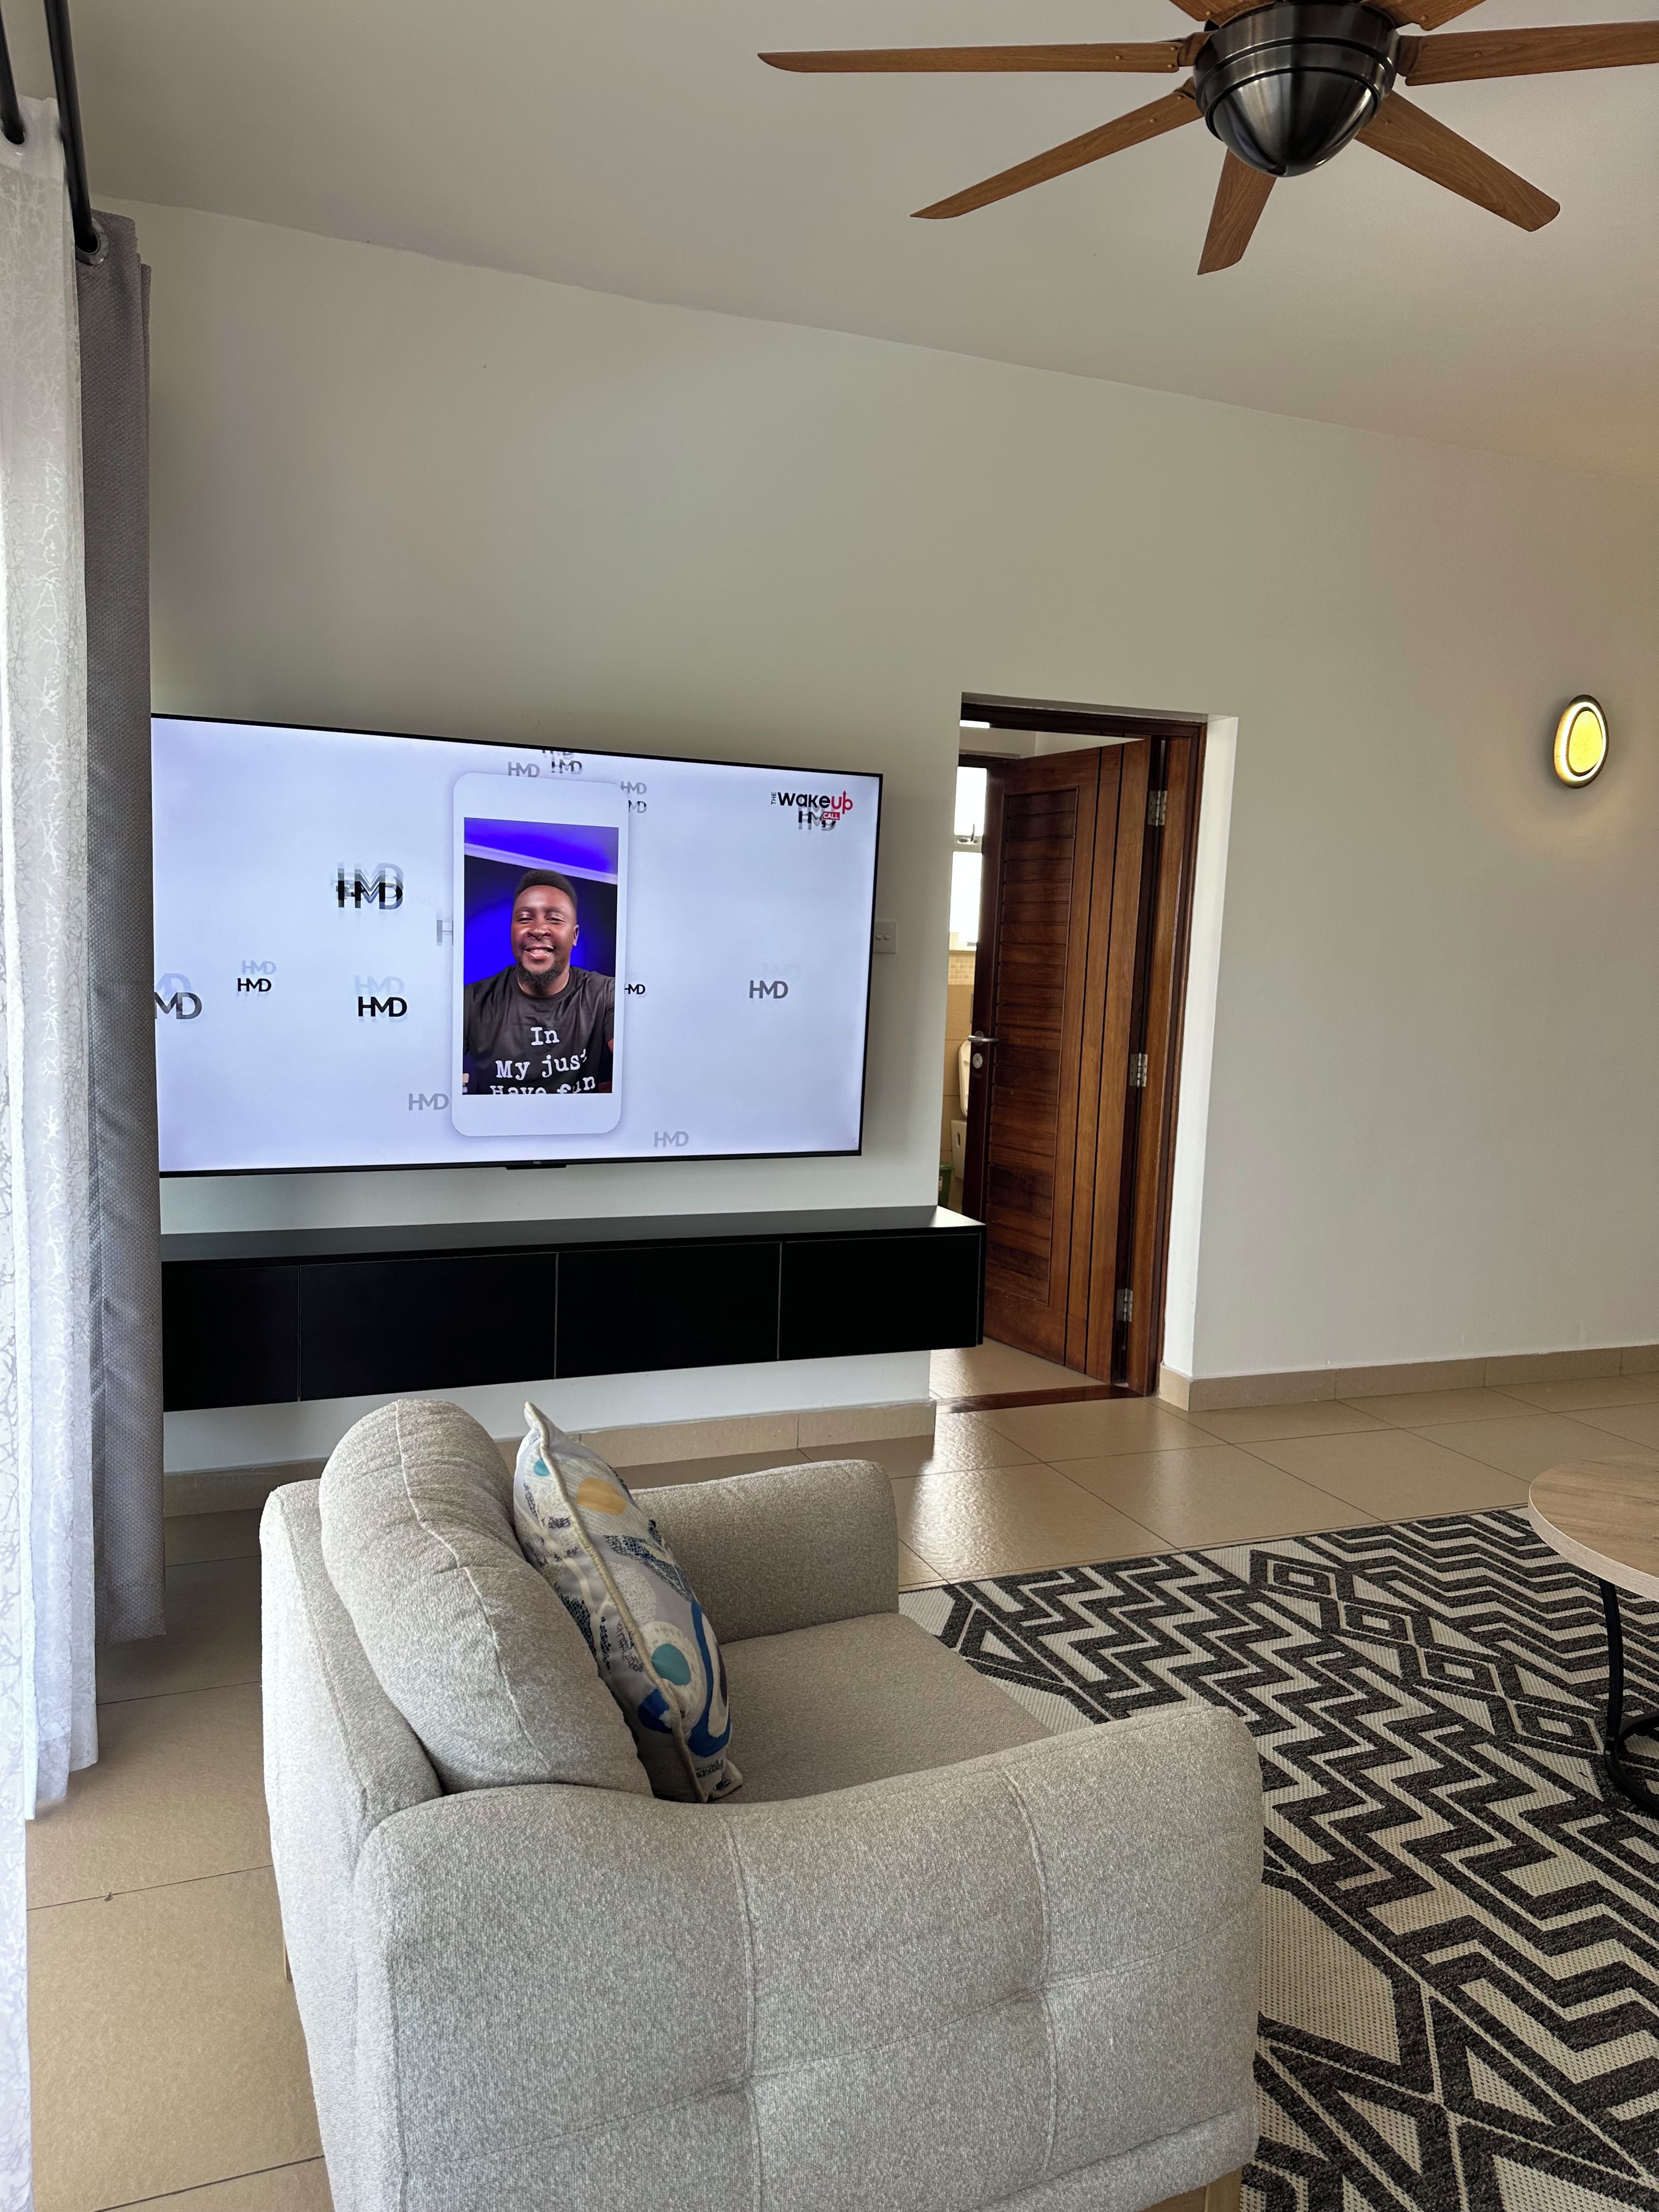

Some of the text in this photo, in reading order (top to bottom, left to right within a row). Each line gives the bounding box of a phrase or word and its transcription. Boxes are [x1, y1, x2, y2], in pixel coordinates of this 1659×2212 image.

[508, 762, 540, 777] HMD
[628, 800, 647, 813] MD
[237, 978, 271, 992] HMD
[749, 980, 789, 999] HMD
[154, 992, 202, 1019] MD
[358, 997, 407, 1017] HMD
[531, 1027, 560, 1046] In
[495, 1060, 530, 1080] My
[408, 1093, 449, 1110] HMD
[654, 1131, 690, 1147] HMD
